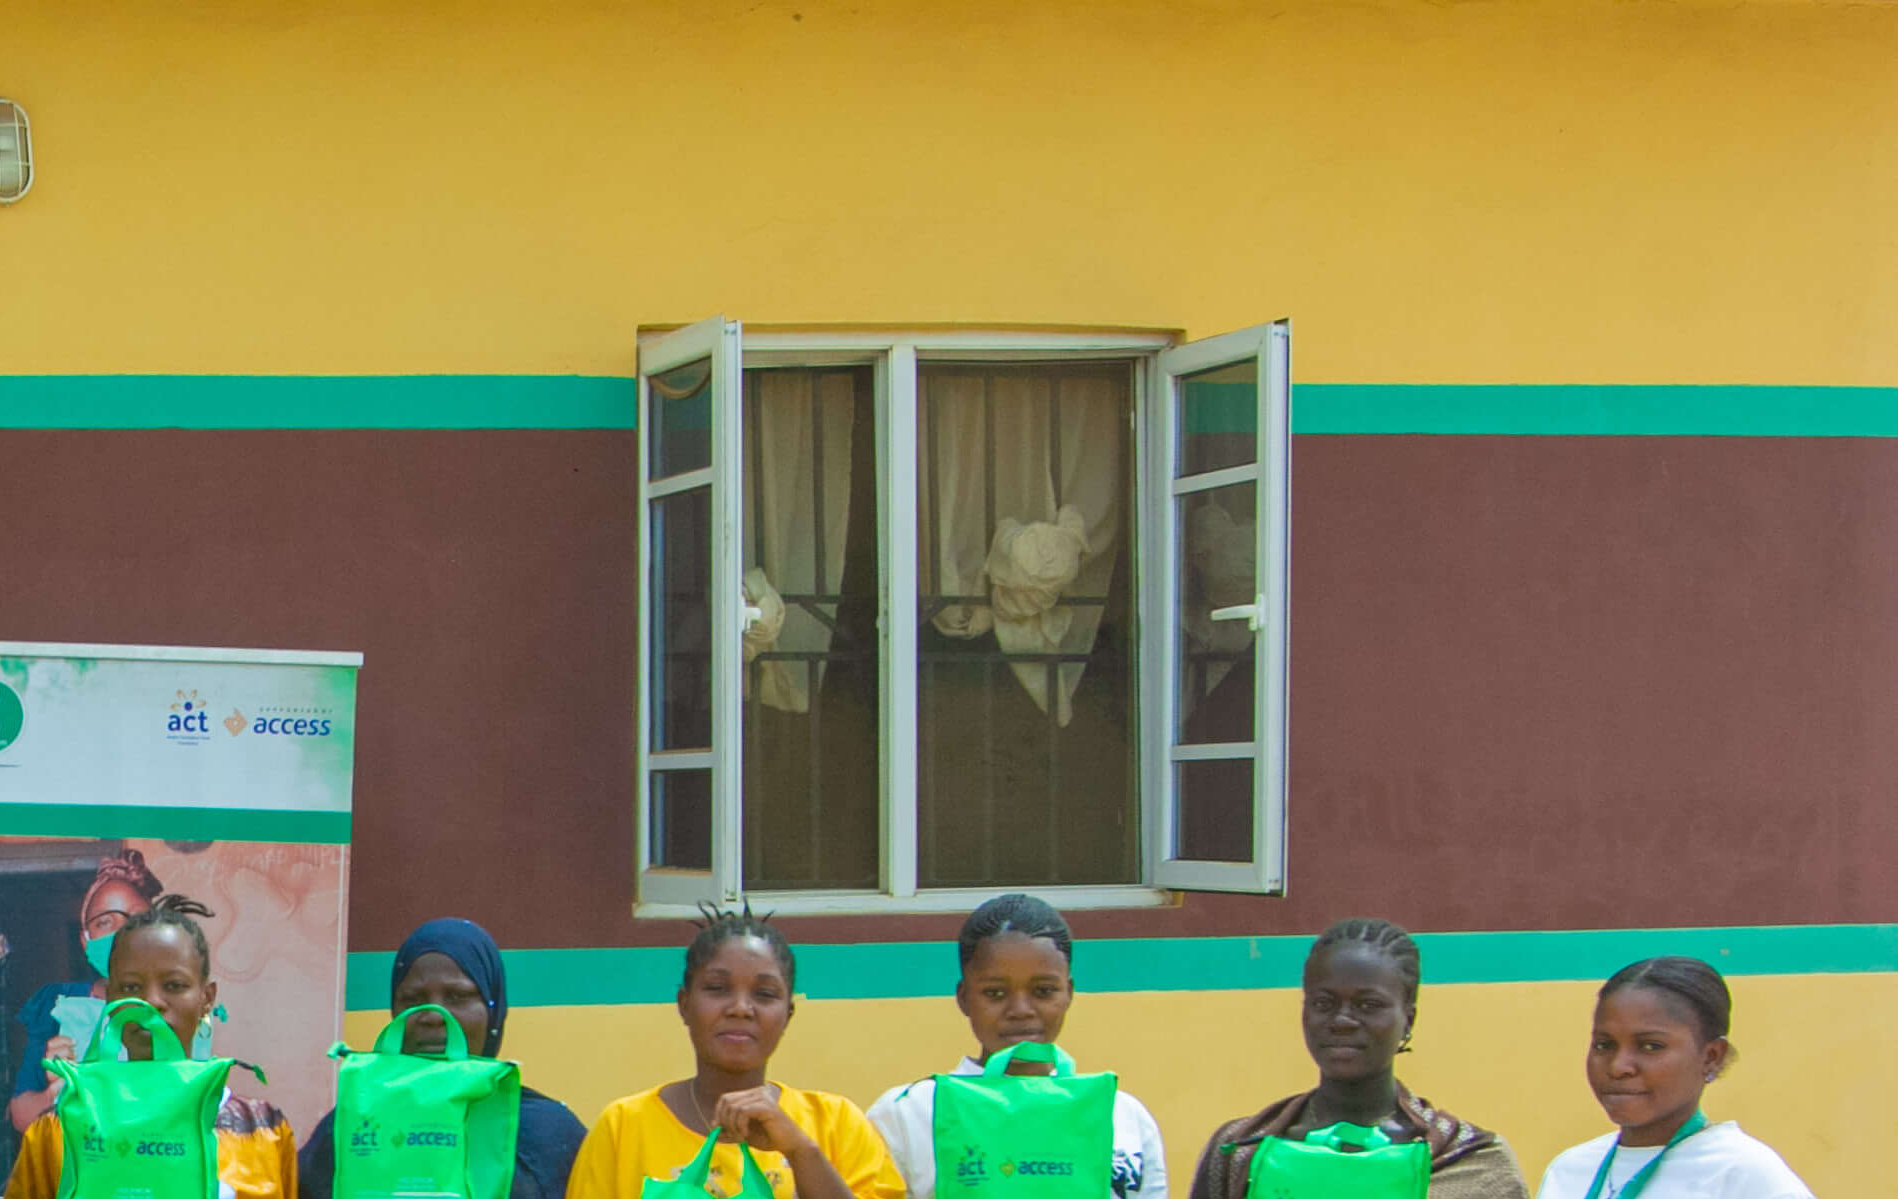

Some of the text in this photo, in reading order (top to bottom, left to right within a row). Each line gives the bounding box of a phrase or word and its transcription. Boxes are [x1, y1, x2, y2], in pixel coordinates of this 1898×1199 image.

[167, 711, 209, 733] act
[253, 716, 332, 737] access
[136, 1140, 185, 1156] access
